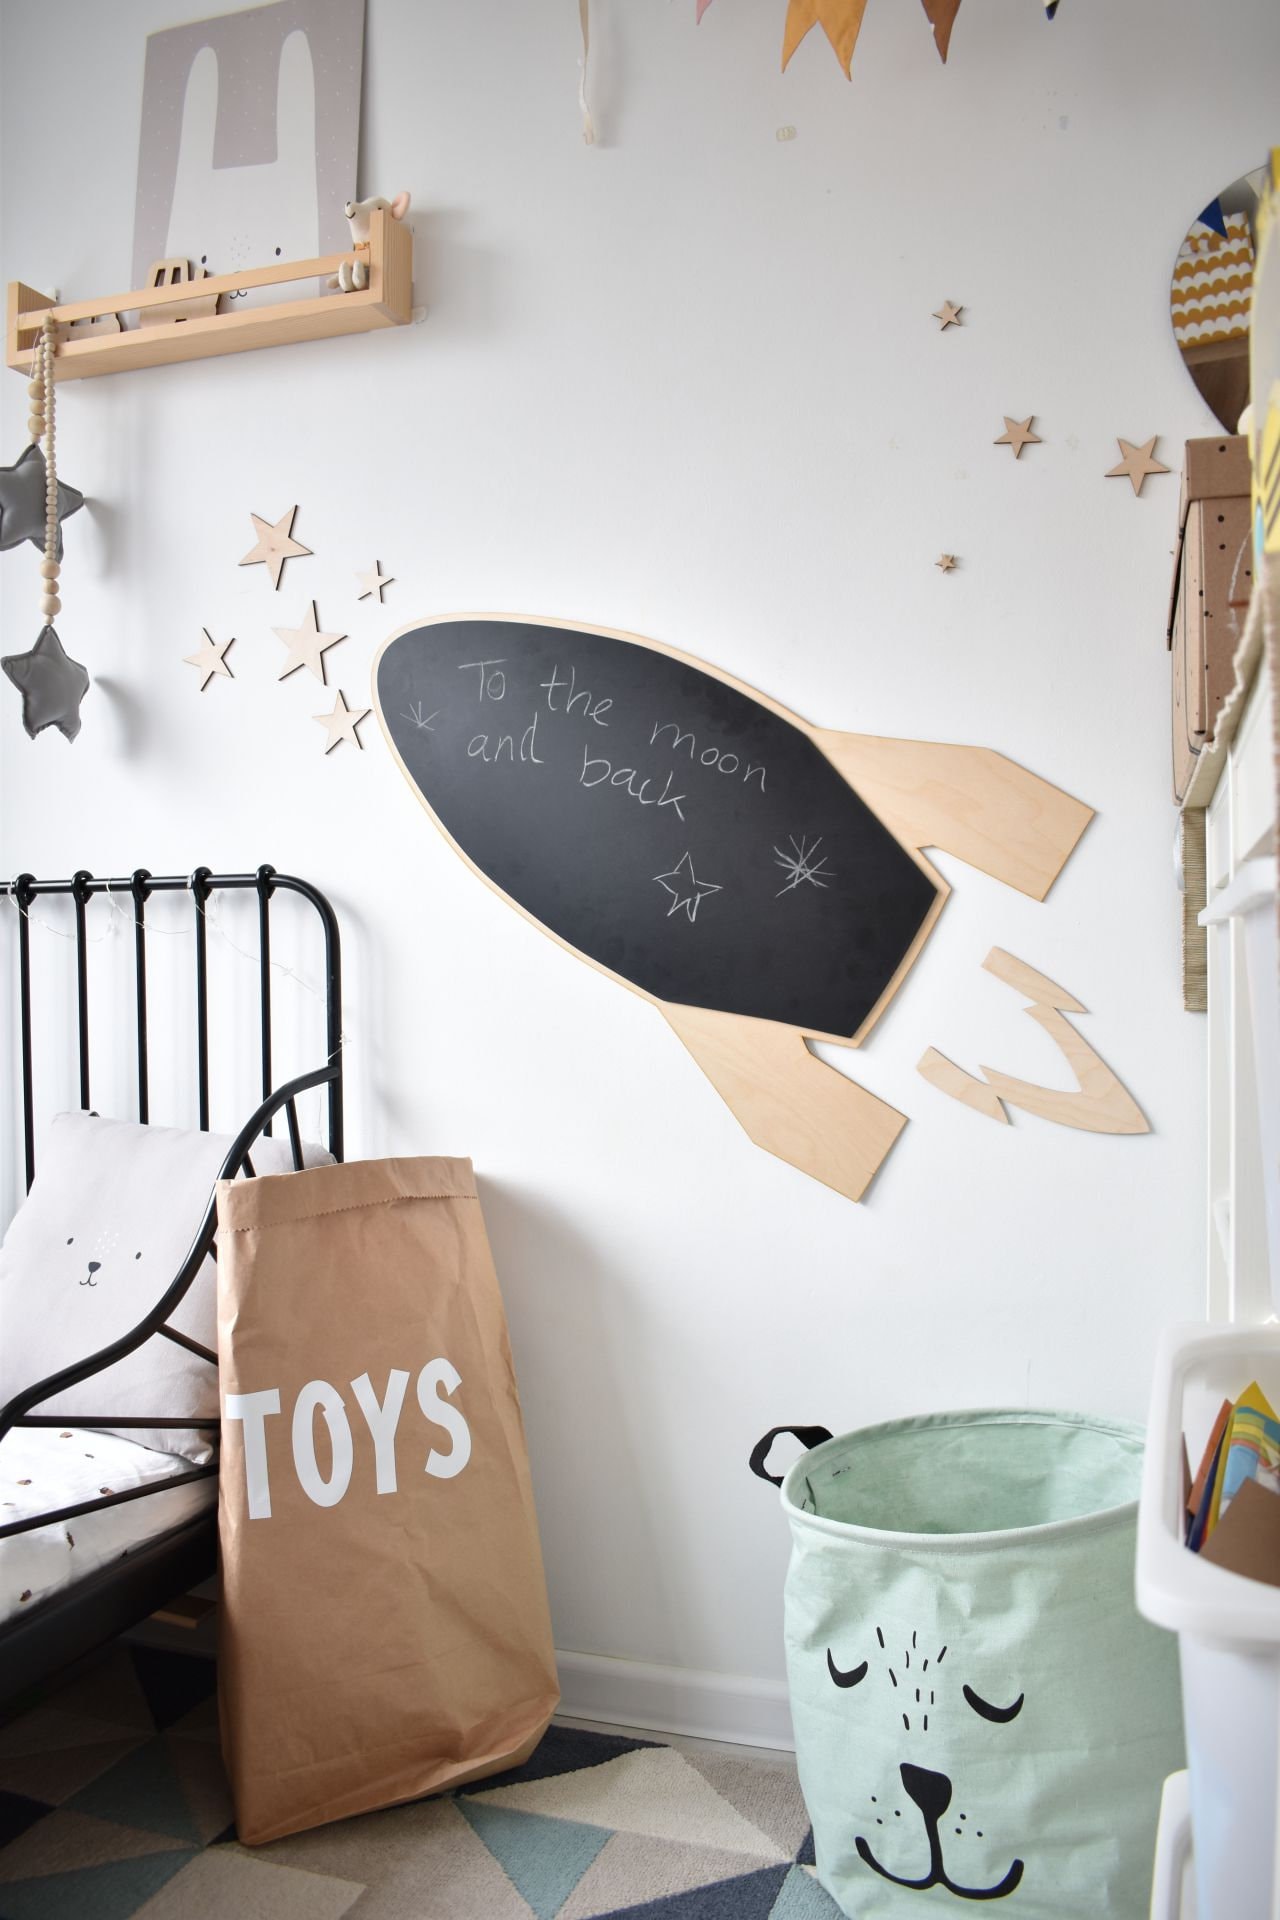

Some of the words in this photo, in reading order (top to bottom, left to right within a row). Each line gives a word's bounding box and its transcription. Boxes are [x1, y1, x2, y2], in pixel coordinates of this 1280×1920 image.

[458, 659, 507, 702] To
[540, 664, 613, 727] the
[649, 721, 766, 792] moon
[467, 712, 544, 763] and
[579, 744, 686, 821] back
[224, 1357, 472, 1520] TOYS
